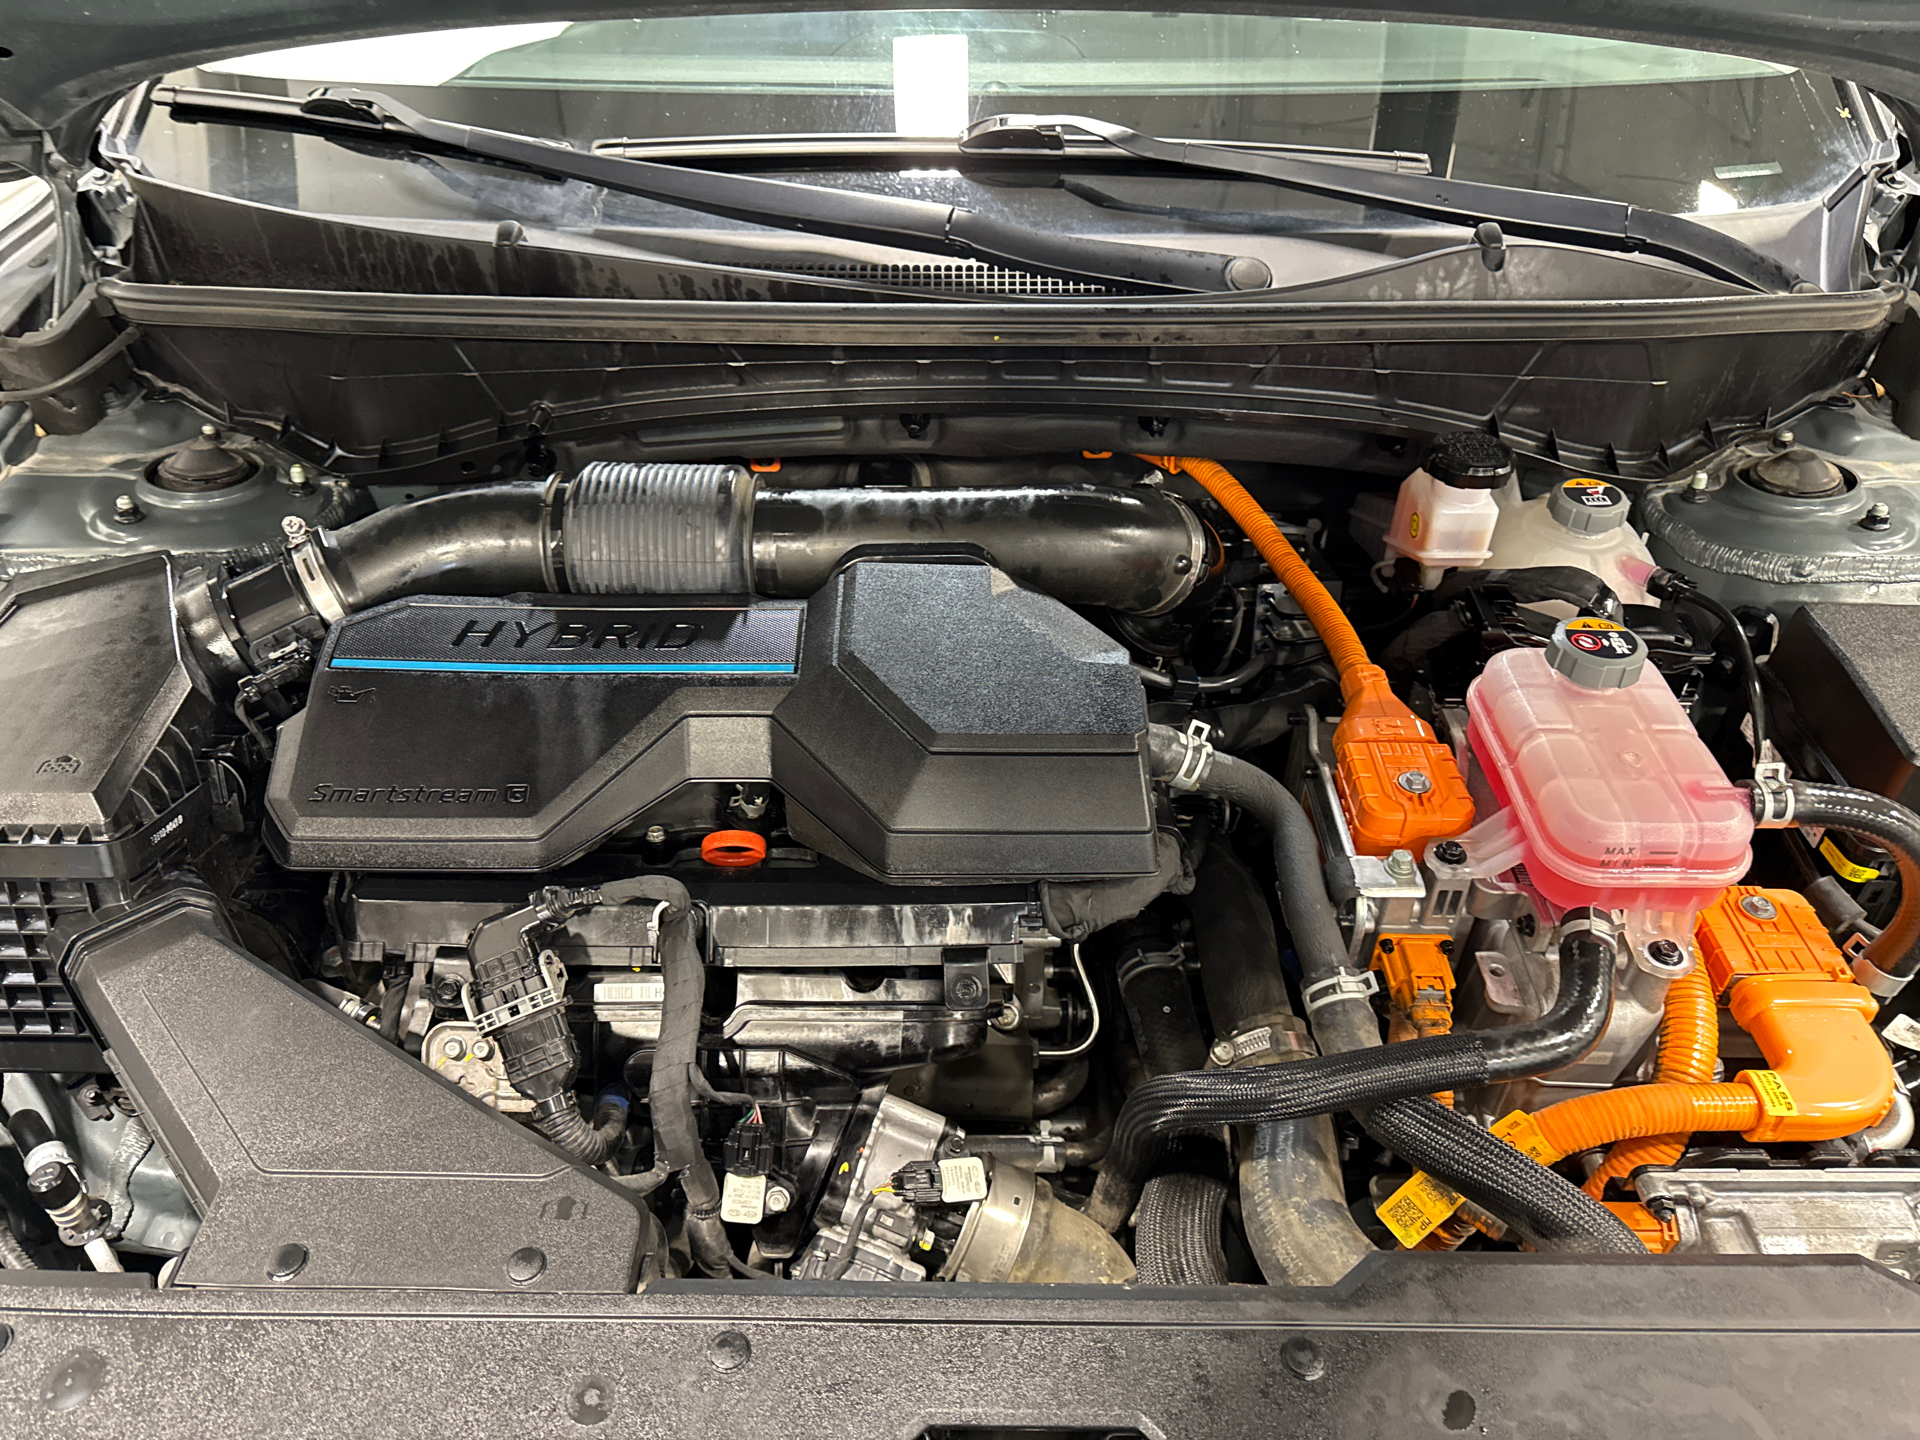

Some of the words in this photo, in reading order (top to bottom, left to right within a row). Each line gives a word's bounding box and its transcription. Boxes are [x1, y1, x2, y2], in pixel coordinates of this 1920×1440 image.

[449, 618, 706, 652] HYBRID
[308, 783, 499, 804] Smartstream
[1604, 846, 1636, 856] MAX
[1599, 859, 1632, 868] MIN
[1767, 1072, 1794, 1112] PASS
[1419, 1216, 1433, 1231] MP
